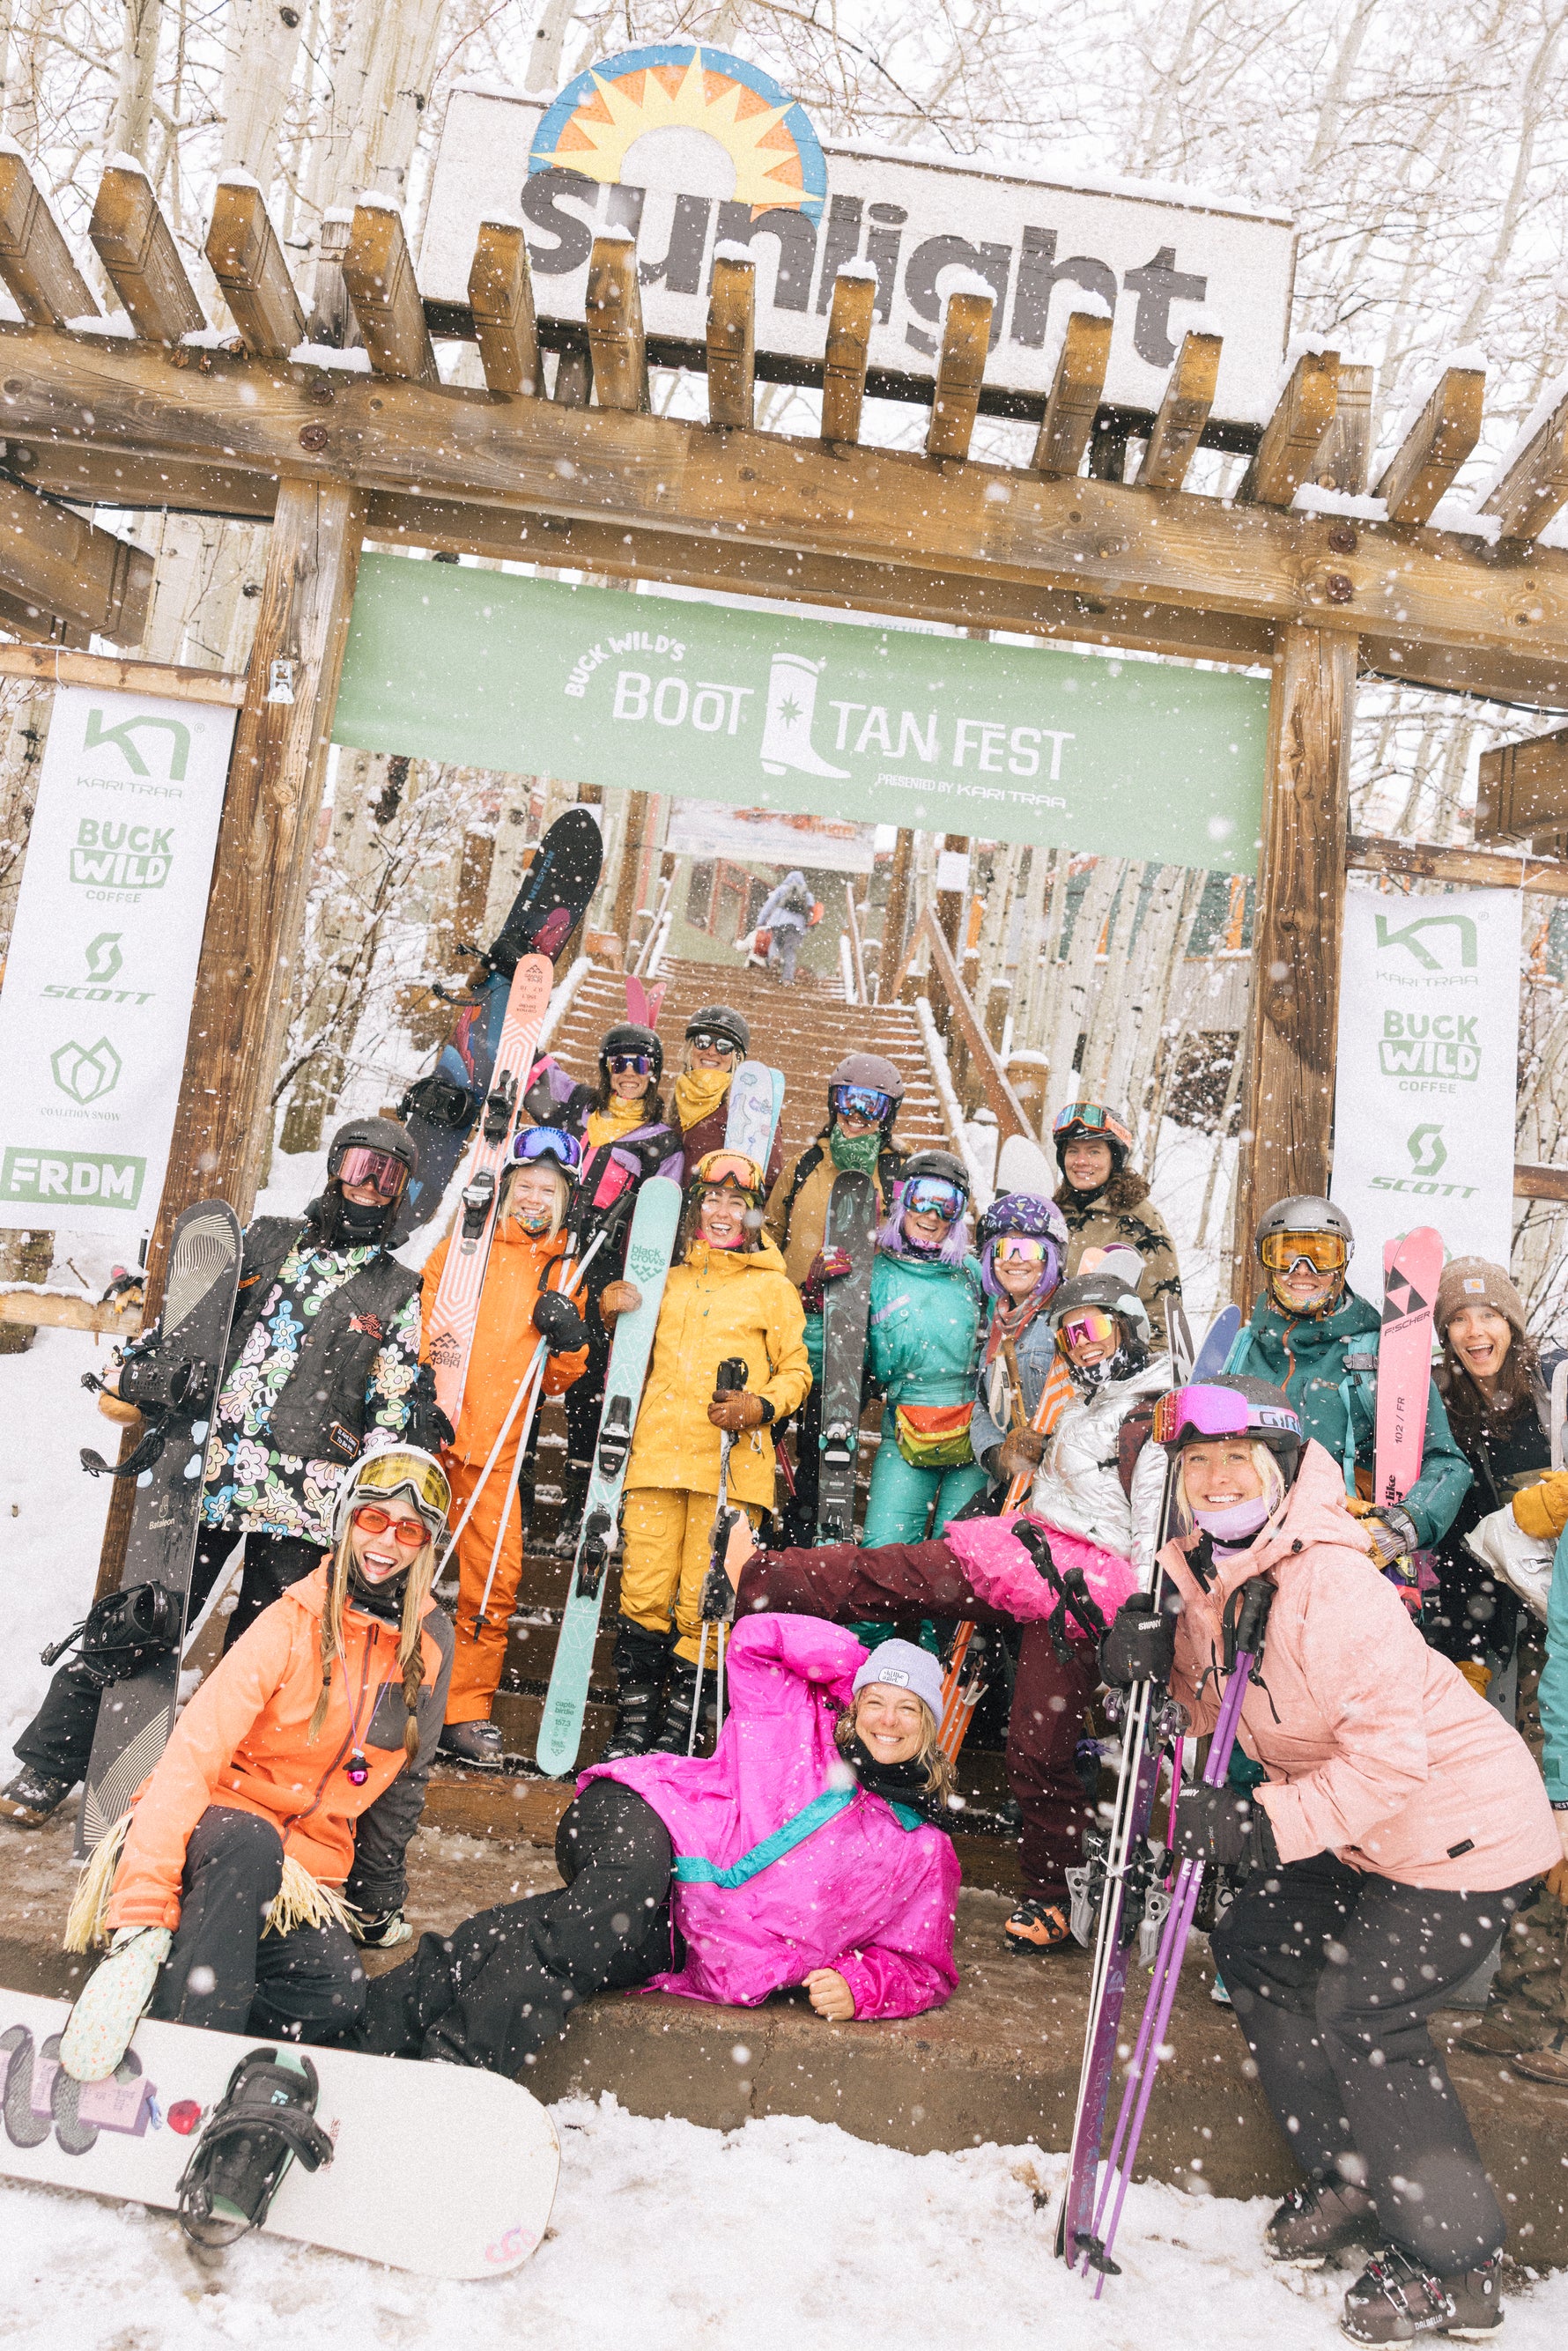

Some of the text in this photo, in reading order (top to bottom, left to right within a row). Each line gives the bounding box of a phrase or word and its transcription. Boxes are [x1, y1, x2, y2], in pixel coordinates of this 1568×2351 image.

[521, 167, 1207, 367] sunlight
[564, 631, 687, 699] BUCK WILD'S
[612, 670, 1076, 781] BOOT TAN FEST
[77, 776, 183, 799] KARI TRAA
[876, 773, 1067, 810] PRESENTED BY KARI TRAA
[77, 817, 175, 854] BUCK
[73, 850, 166, 885] WILD
[528, 849, 556, 900] WESTON
[85, 889, 142, 904] COFFEE
[1375, 971, 1479, 987] KARI TRAA
[39, 984, 157, 1006] SCOTT
[1383, 1009, 1479, 1045] BUCK
[1381, 1040, 1480, 1076] WILD
[1398, 1080, 1457, 1095] COFFEE
[41, 1106, 122, 1122] COALITION SNOW
[10, 1157, 137, 1201] FRDM
[1366, 1176, 1481, 1199] SCOTT
[631, 1253, 666, 1267] crows
[632, 1243, 661, 1258] black
[1383, 1310, 1431, 1337] FISCHER
[431, 1357, 461, 1369] black
[1396, 1396, 1406, 1412] FR
[1394, 1425, 1404, 1445] 102
[1385, 1475, 1396, 1501] like
[148, 1518, 175, 1530] Bataleon
[1414, 2313, 1444, 2332] DALBELLO
